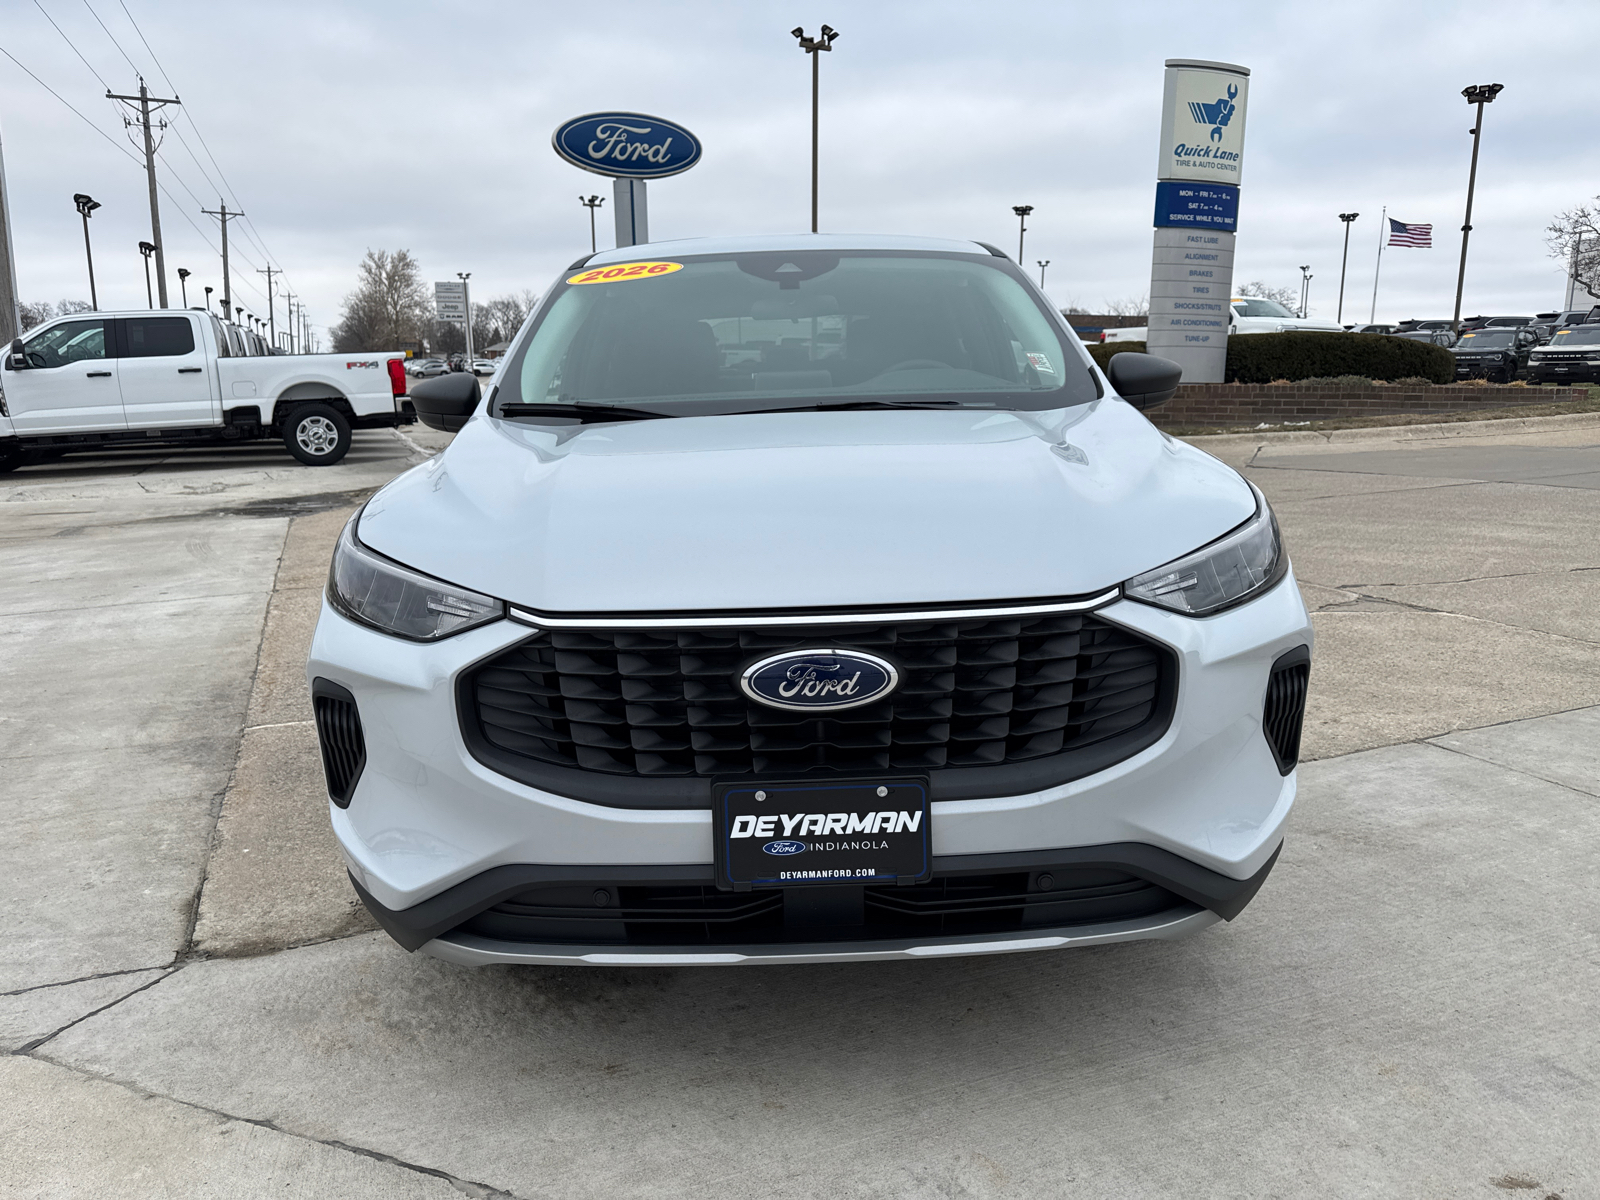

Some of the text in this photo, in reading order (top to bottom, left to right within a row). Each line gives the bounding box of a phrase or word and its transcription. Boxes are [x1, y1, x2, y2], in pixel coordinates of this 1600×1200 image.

[588, 123, 673, 163] Ford
[1174, 143, 1239, 161] Quick Lane
[1198, 161, 1216, 169] AUTO
[1216, 162, 1237, 172] CENTER
[1184, 253, 1218, 261] ALIGNMENT
[578, 264, 672, 283] 2026
[1189, 270, 1213, 278] BRAKES
[1174, 302, 1222, 311] SHOCKS/STRUTS
[346, 361, 379, 370] FX4
[778, 664, 861, 698] Ford
[730, 810, 922, 838] DEYARMAN
[772, 840, 889, 853] Ford INDIANOLA
[780, 868, 876, 879] DEYARMANFORD.COM
